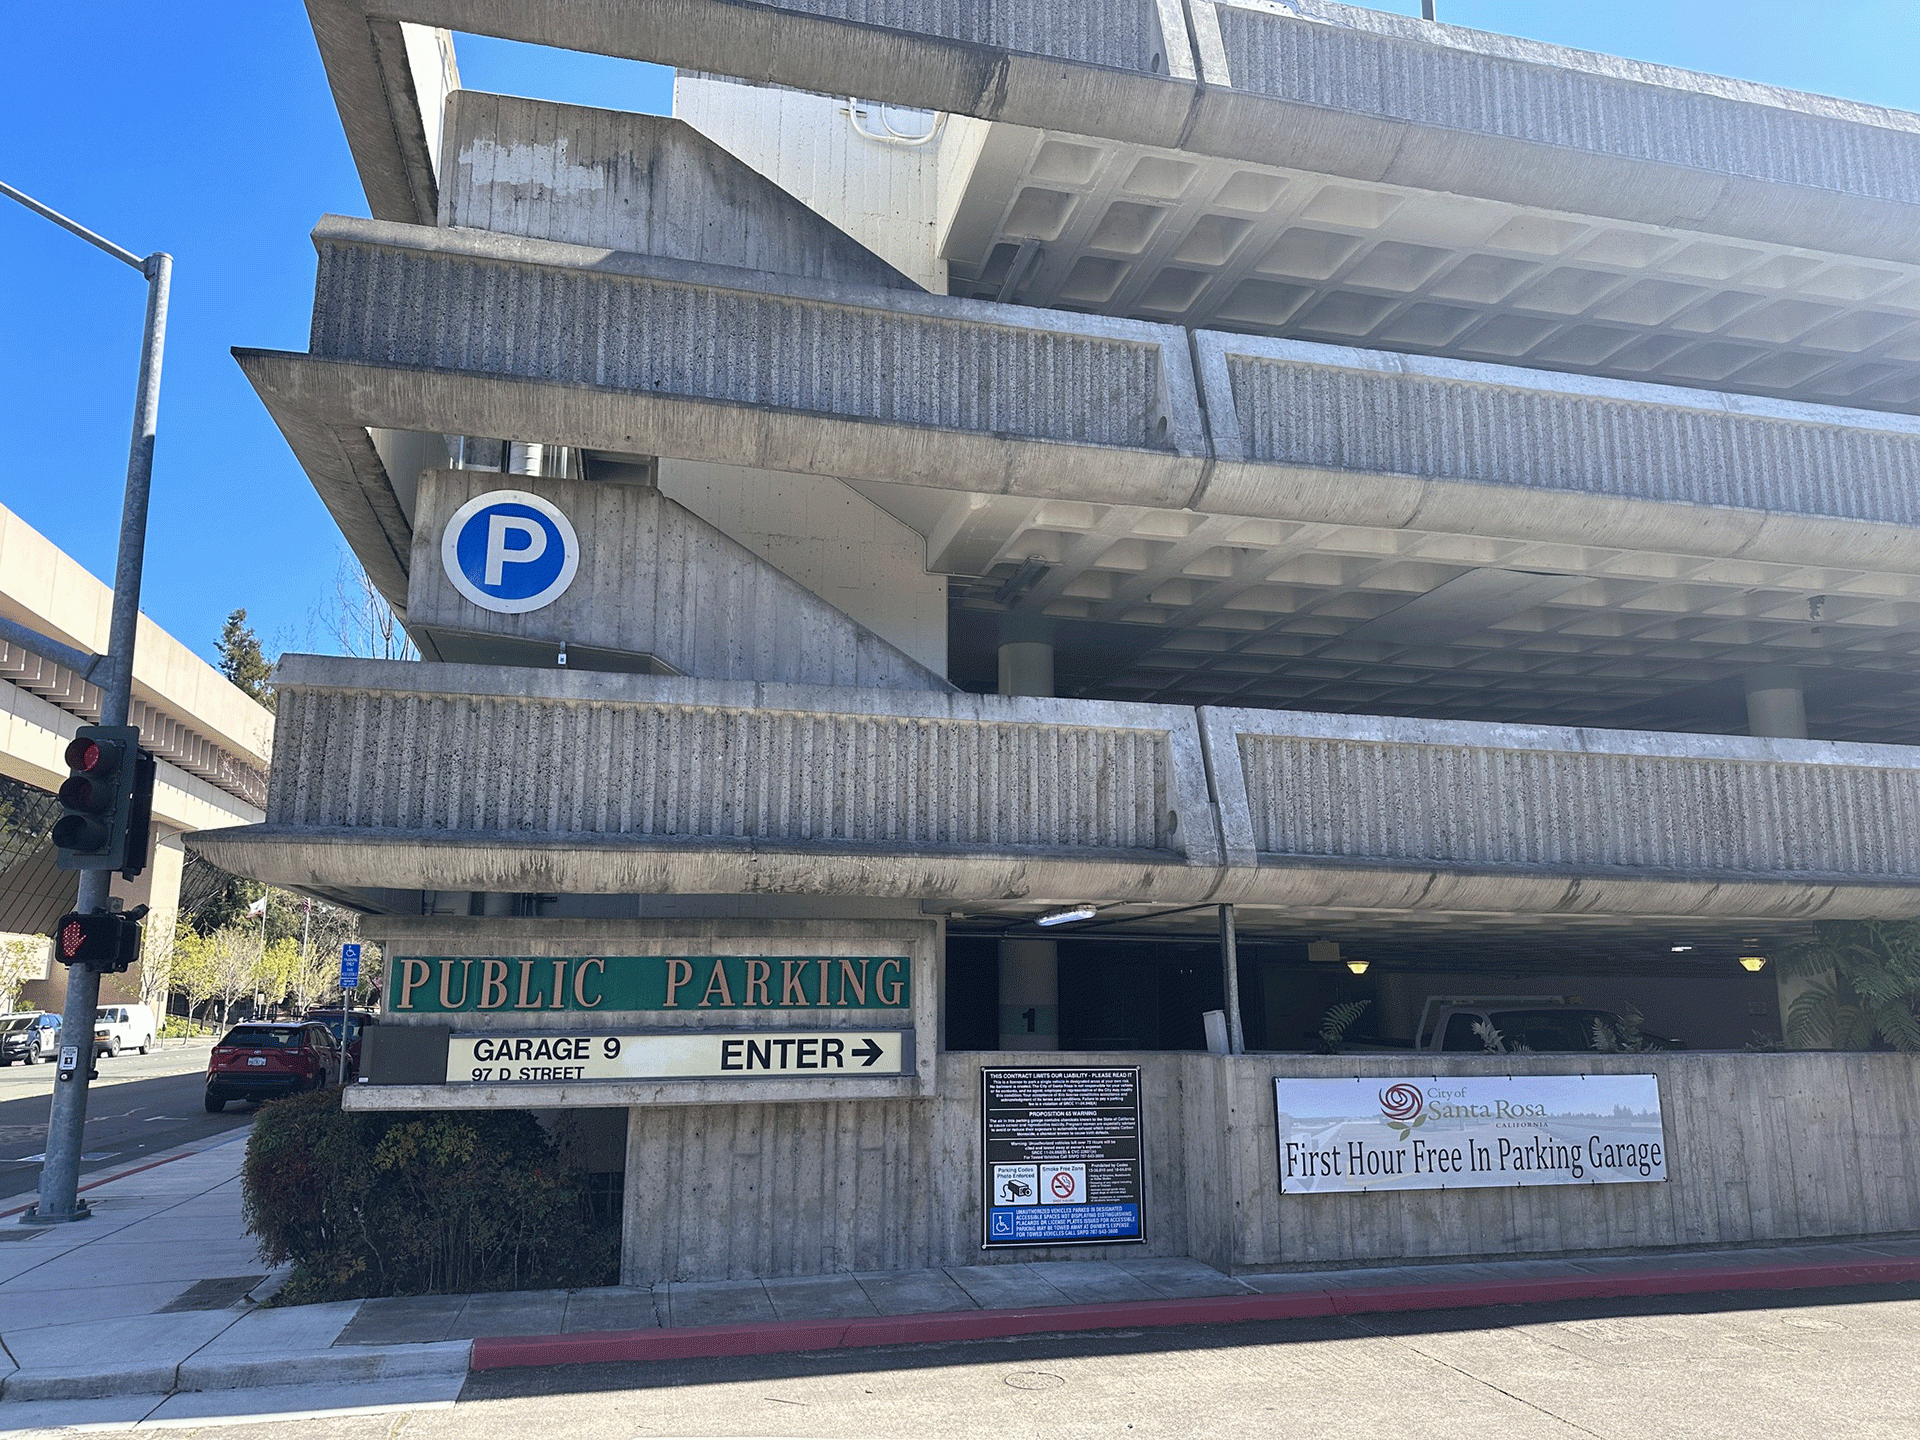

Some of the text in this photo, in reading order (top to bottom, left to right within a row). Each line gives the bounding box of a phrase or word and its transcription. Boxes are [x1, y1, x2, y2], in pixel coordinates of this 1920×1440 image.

[485, 514, 548, 586] P
[399, 958, 905, 1009] PUBLIC PARKING
[1021, 1007, 1036, 1033] 1
[473, 1037, 621, 1062] GARAGE 9
[720, 1038, 844, 1071] ENTER
[472, 1066, 585, 1082] 97 D STREET
[1427, 1087, 1467, 1101] City of
[1428, 1100, 1547, 1120] Santa Rosa
[1285, 1135, 1662, 1178] First Hour Free In Parking Garage
